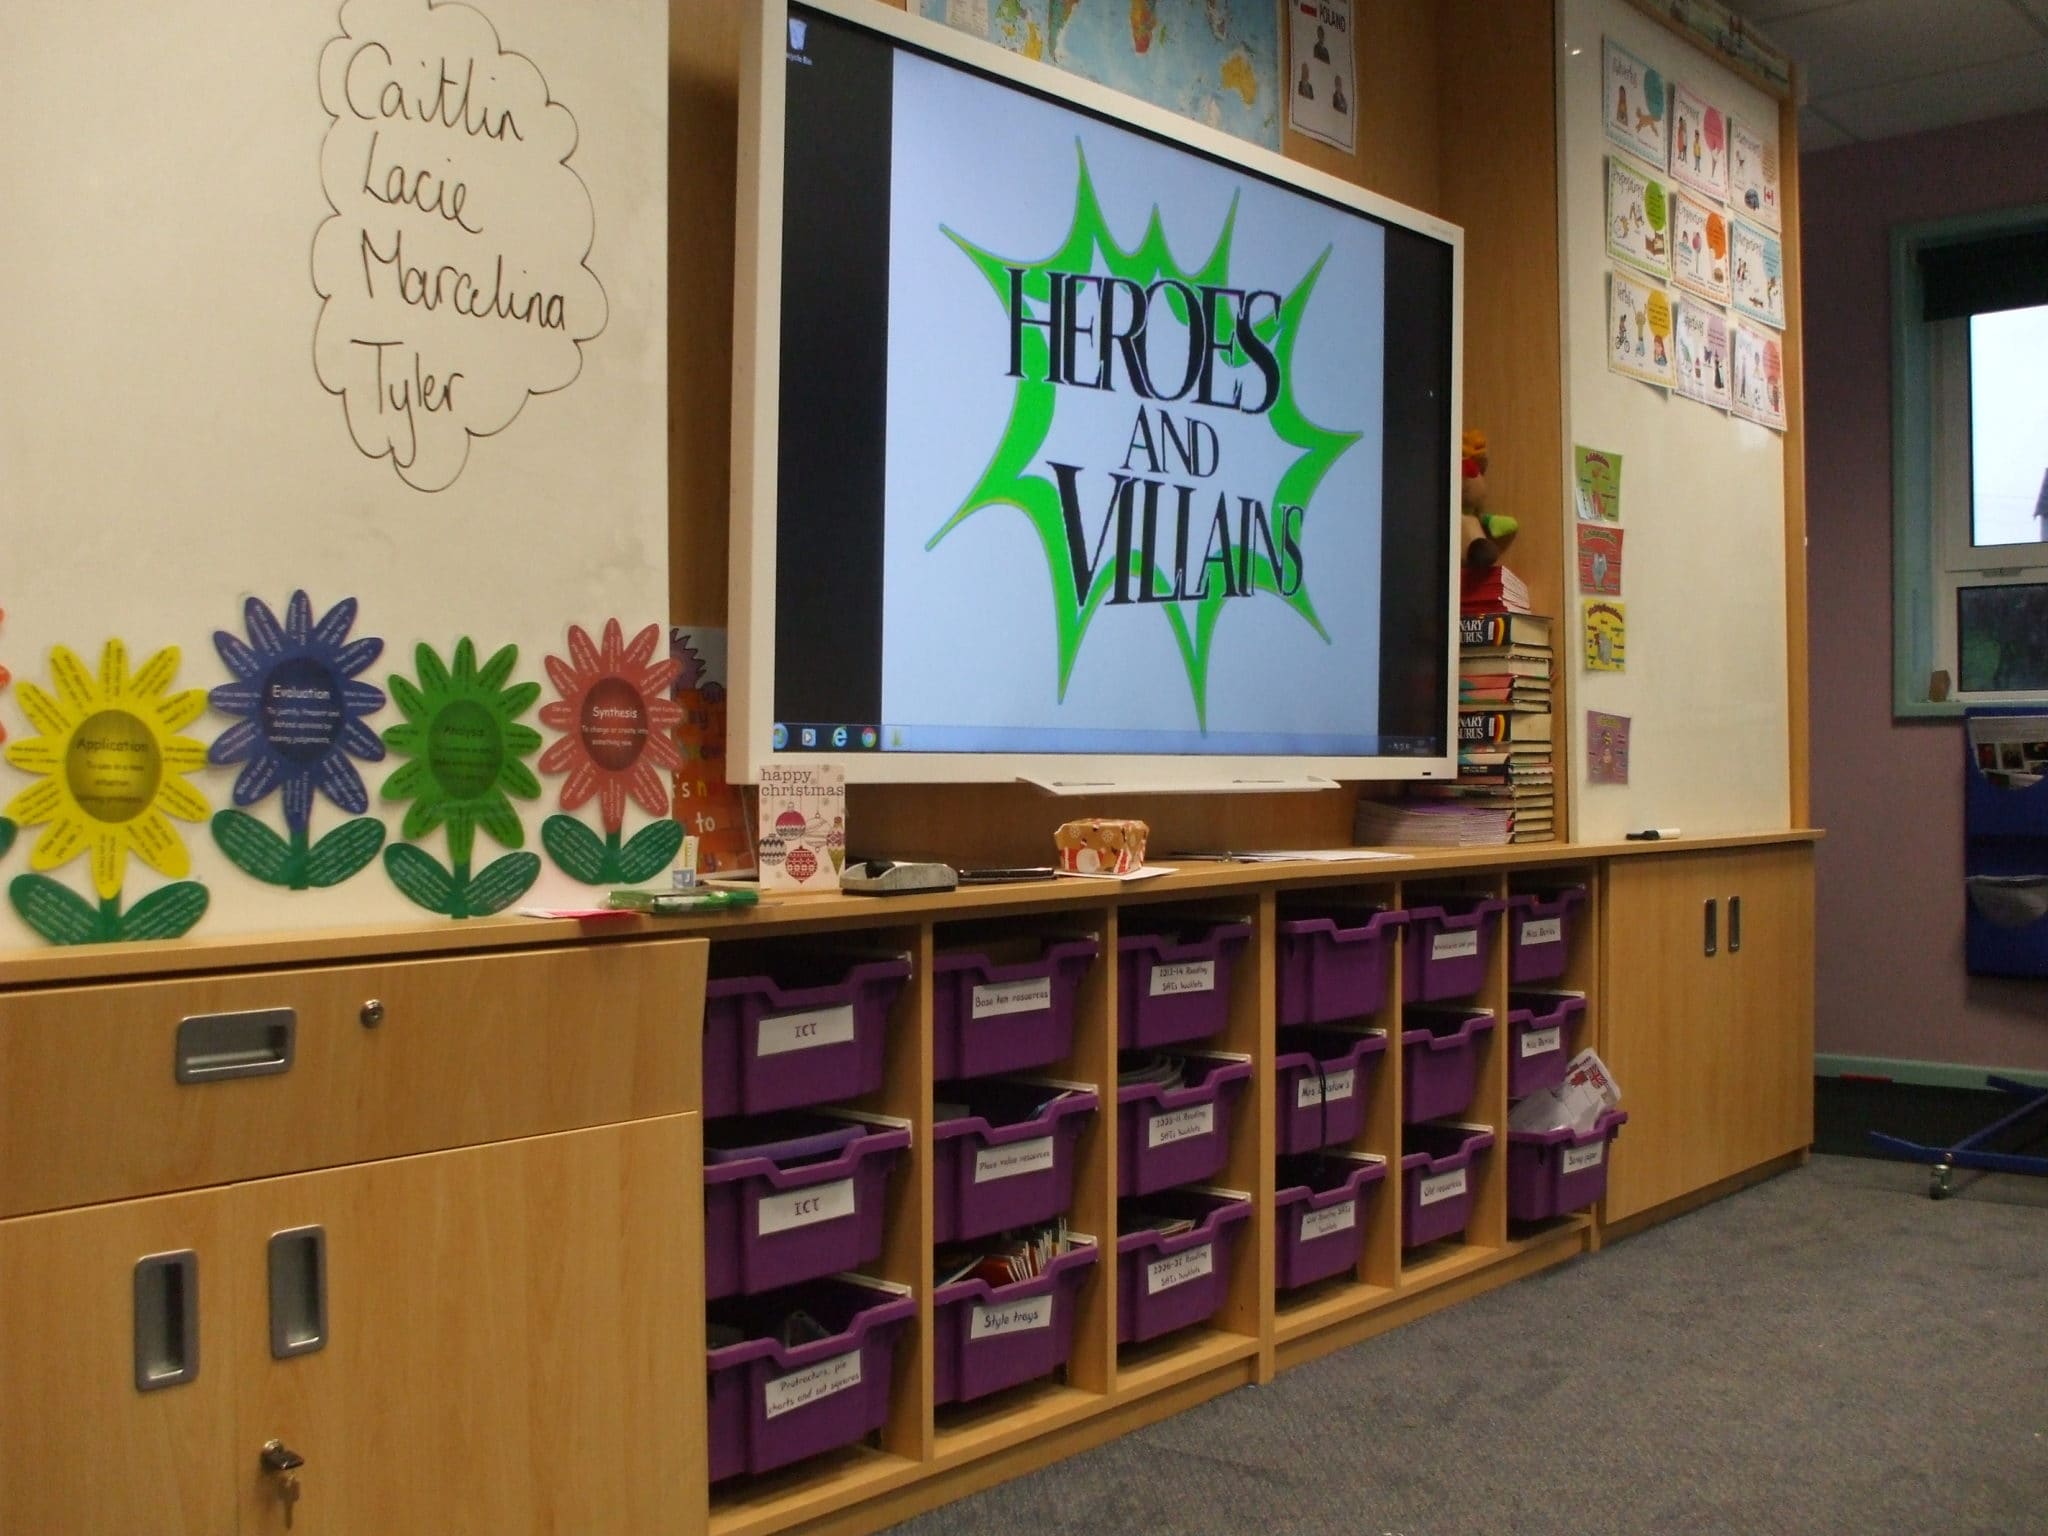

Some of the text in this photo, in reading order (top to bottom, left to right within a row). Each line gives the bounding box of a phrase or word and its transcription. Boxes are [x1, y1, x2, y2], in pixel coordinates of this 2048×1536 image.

[345, 42, 524, 141] Caitlin
[363, 131, 484, 234] Lacie
[361, 229, 566, 330] Marcelina
[1004, 267, 1282, 415] HEROES
[350, 338, 464, 468] Tyler
[1120, 404, 1220, 478] AND
[1046, 460, 1304, 607] VILLAINS
[272, 684, 331, 700] Evaluation
[592, 706, 638, 720] Synthesis
[761, 768, 812, 784] happy
[761, 783, 844, 797] christmas
[695, 811, 716, 833] to
[794, 1022, 818, 1038] ICT
[794, 1196, 821, 1217] ICT
[984, 1310, 1039, 1329] Style trays
